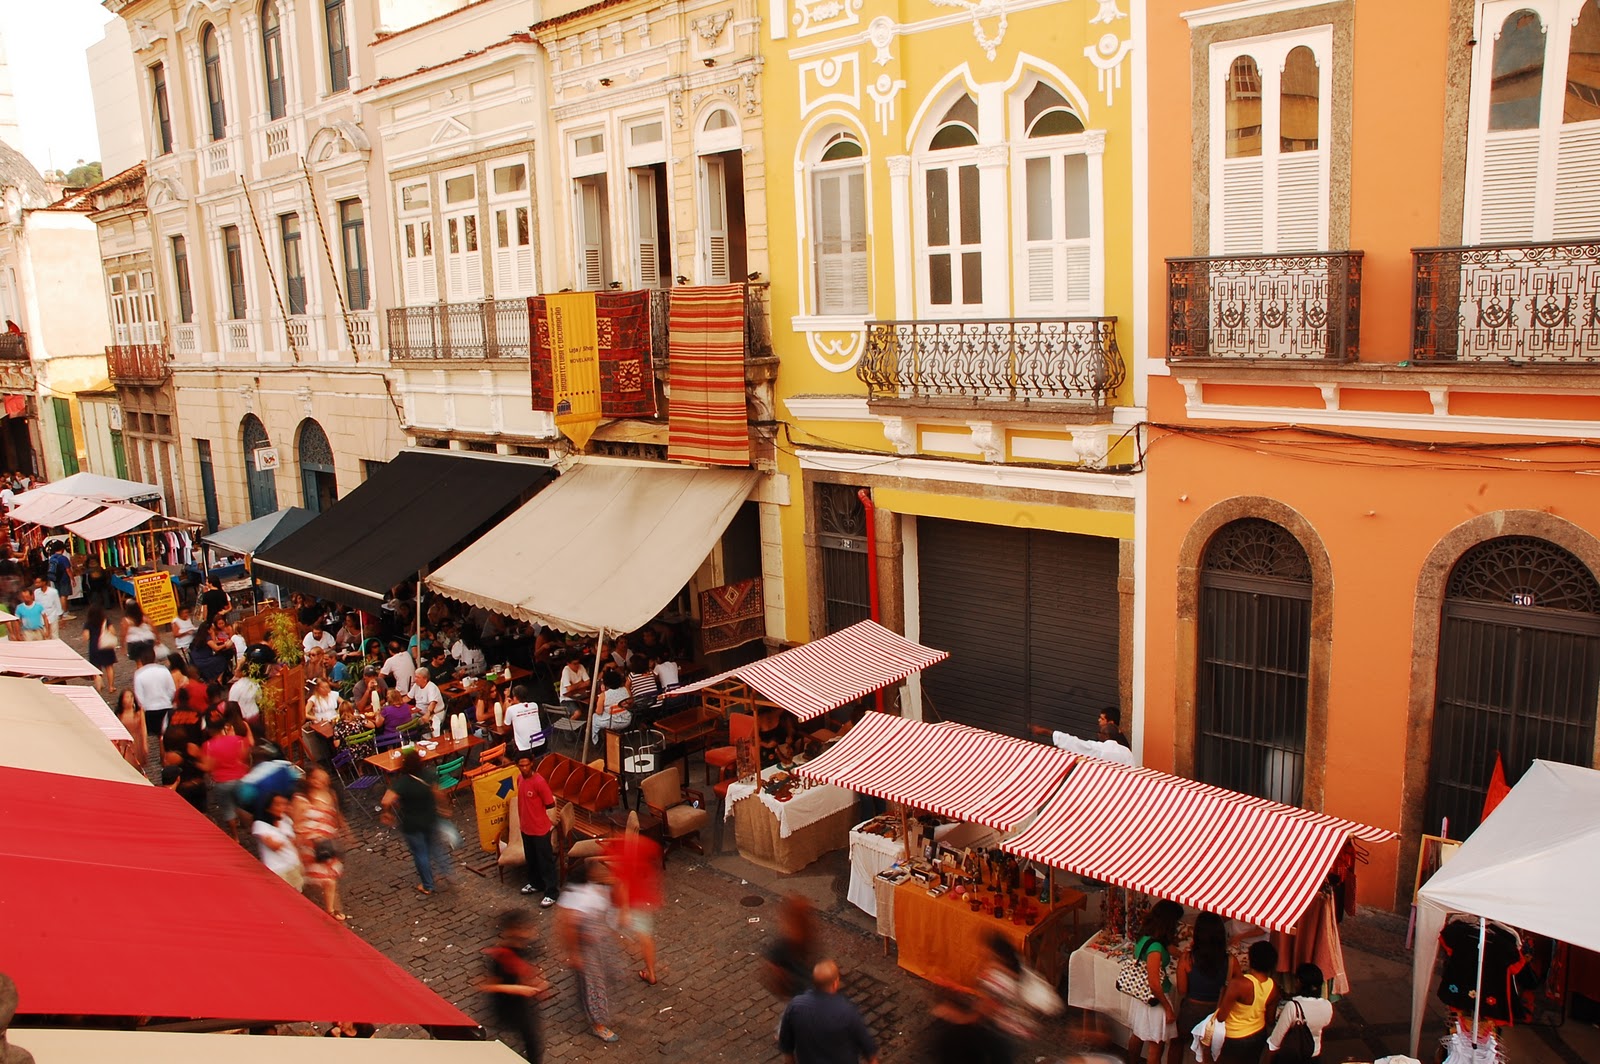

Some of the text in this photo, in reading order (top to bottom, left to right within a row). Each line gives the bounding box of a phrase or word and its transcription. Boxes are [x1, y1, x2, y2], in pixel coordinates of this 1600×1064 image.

[555, 307, 564, 343] DECORAÇÃO
[559, 350, 567, 391] ARQUITETURA
[1514, 595, 1532, 606] 30
[490, 816, 504, 825] Loja
